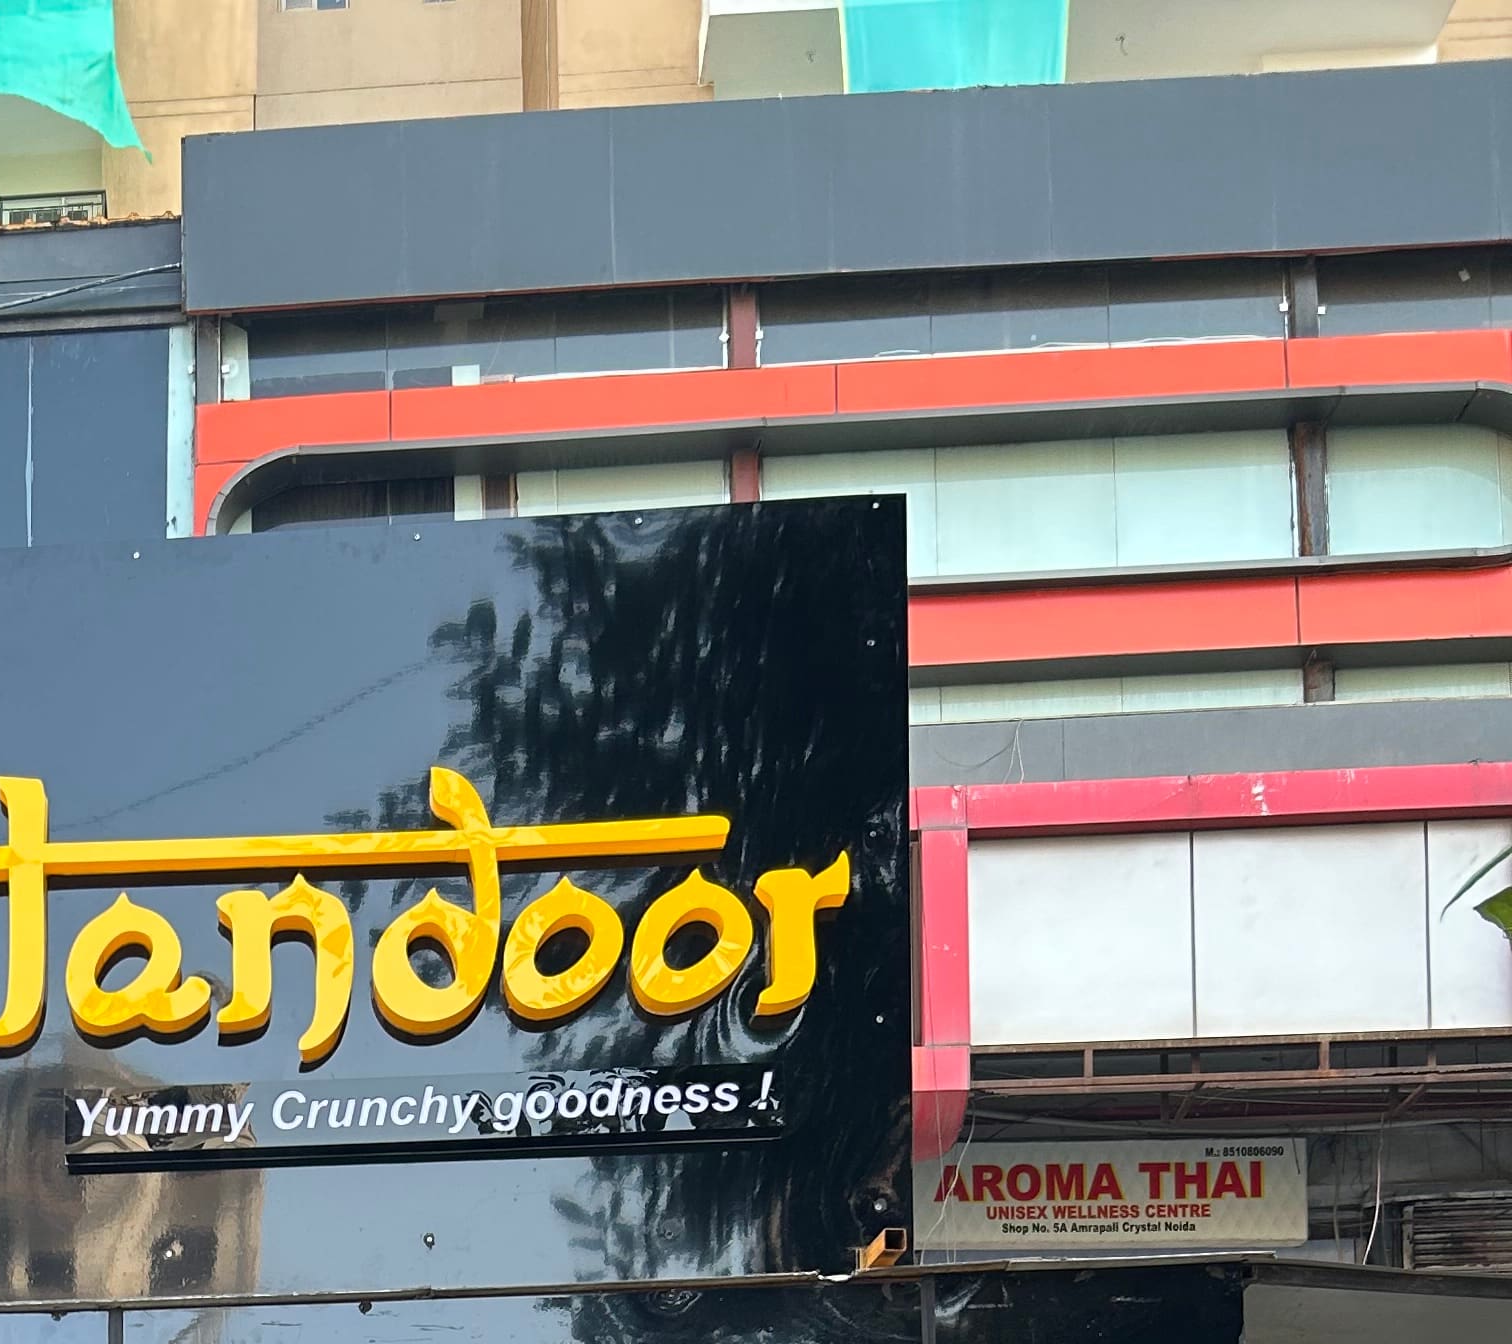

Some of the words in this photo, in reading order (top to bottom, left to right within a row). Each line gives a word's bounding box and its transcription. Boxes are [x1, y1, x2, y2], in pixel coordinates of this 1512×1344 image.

[74, 1096, 255, 1143] Yummy
[271, 1085, 484, 1134] Crunchy
[492, 1077, 741, 1132] goodness
[933, 1162, 1125, 1203] AROMA
[1138, 1160, 1265, 1200] THAI
[986, 1205, 1048, 1220] UNISEX
[1052, 1204, 1140, 1219] WELLNESS
[1145, 1203, 1211, 1217] CENTRE
[1001, 1222, 1029, 1235] Shop
[1032, 1222, 1049, 1233] No.
[1053, 1222, 1067, 1233] 5A
[1070, 1221, 1119, 1235] Amrapali
[1122, 1220, 1161, 1234] Crystal
[1164, 1220, 1196, 1232] Noida
